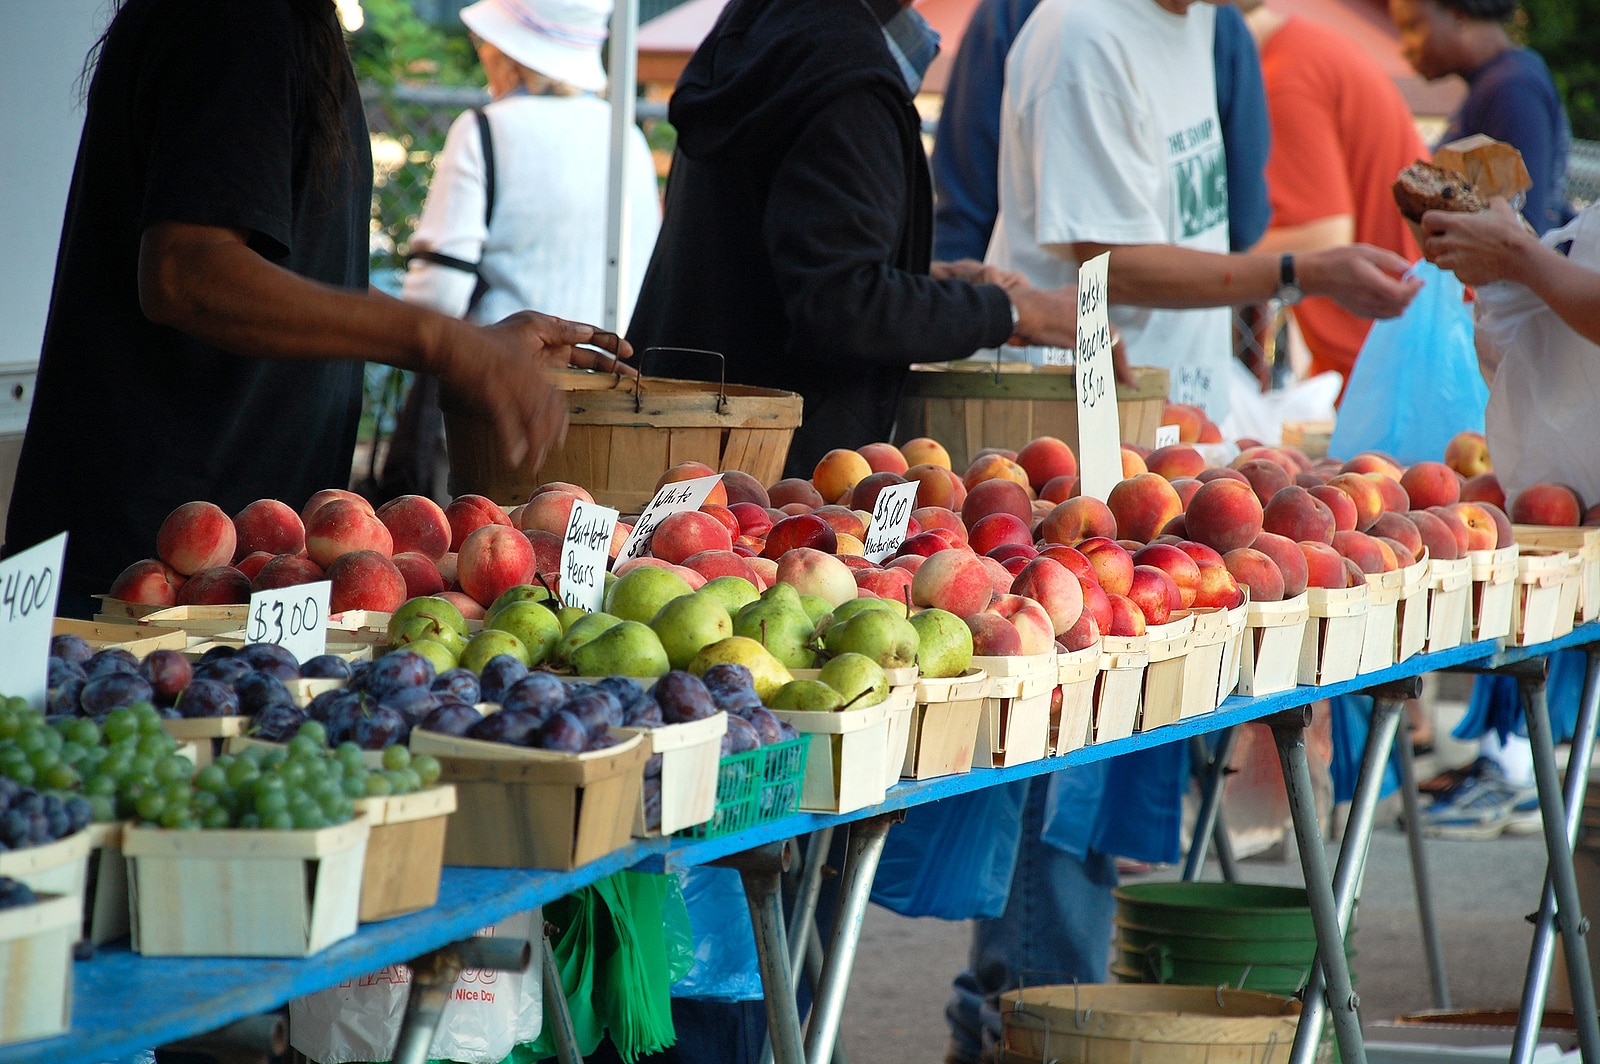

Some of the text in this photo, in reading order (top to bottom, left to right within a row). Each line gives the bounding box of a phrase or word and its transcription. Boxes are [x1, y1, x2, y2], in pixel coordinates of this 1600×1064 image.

[651, 485, 693, 510] White
[874, 490, 908, 532] $5.00
[567, 506, 610, 552] Bartlett
[566, 549, 595, 588] Pears
[0, 566, 53, 623] 4.00
[248, 596, 319, 645] $3.00
[455, 988, 479, 1001] Nice
[480, 989, 496, 1004] Day
